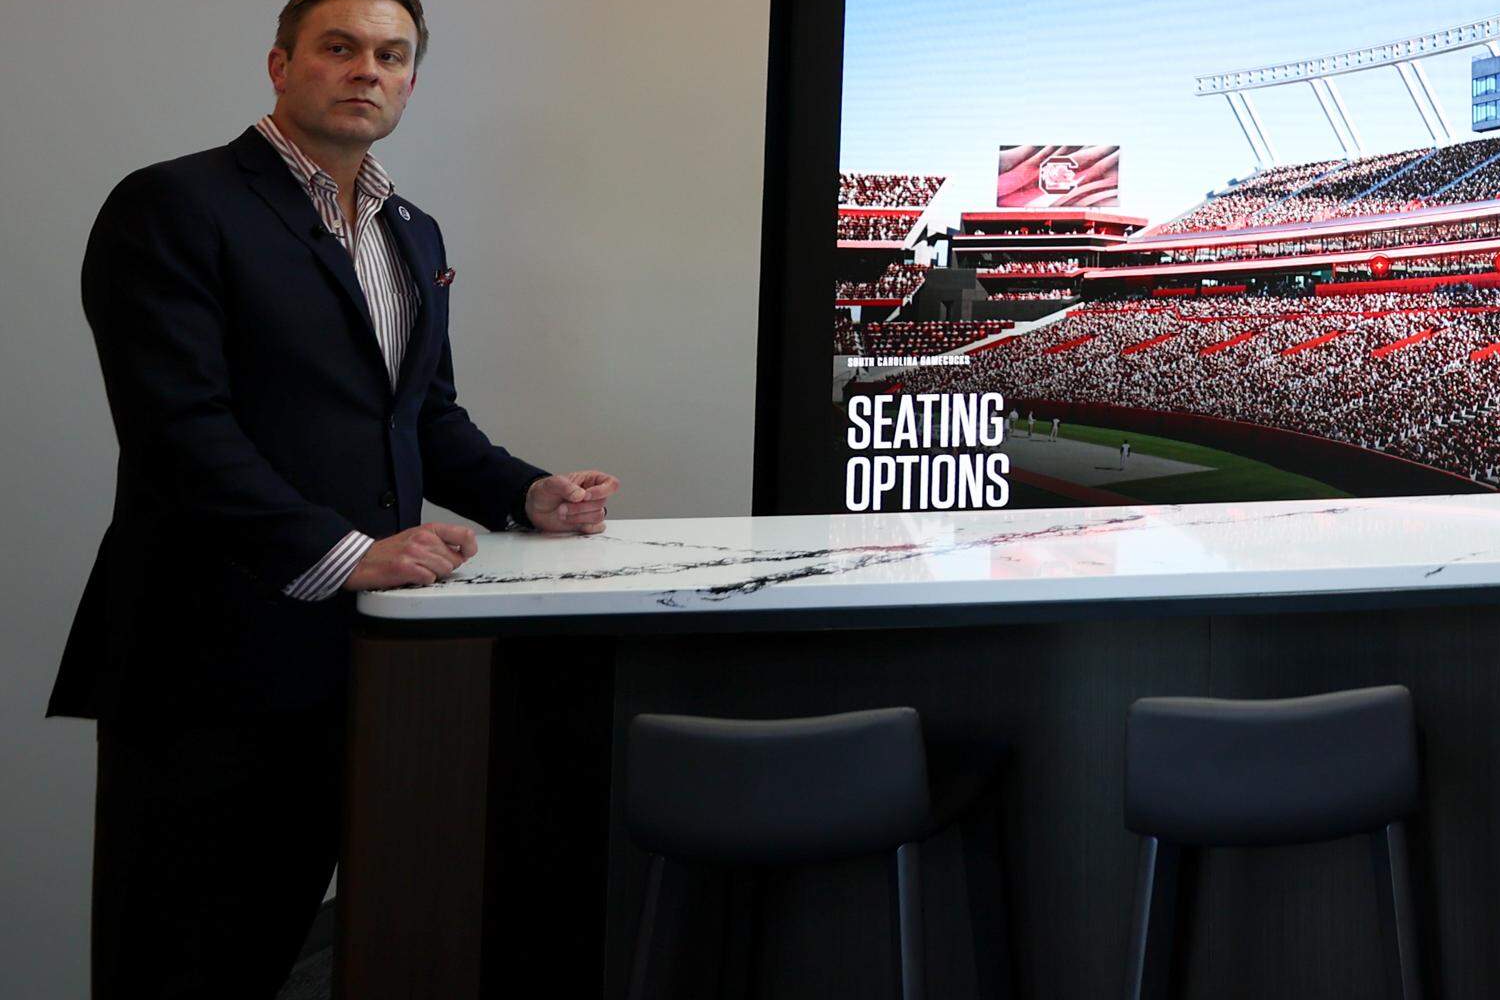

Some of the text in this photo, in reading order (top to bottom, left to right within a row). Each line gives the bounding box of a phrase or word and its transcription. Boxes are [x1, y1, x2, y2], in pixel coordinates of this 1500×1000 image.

[847, 355, 971, 367] SOUTH CAROLINA GAMECOCKS
[847, 392, 1004, 450] SEATING
[845, 453, 1010, 512] OPTIONS
